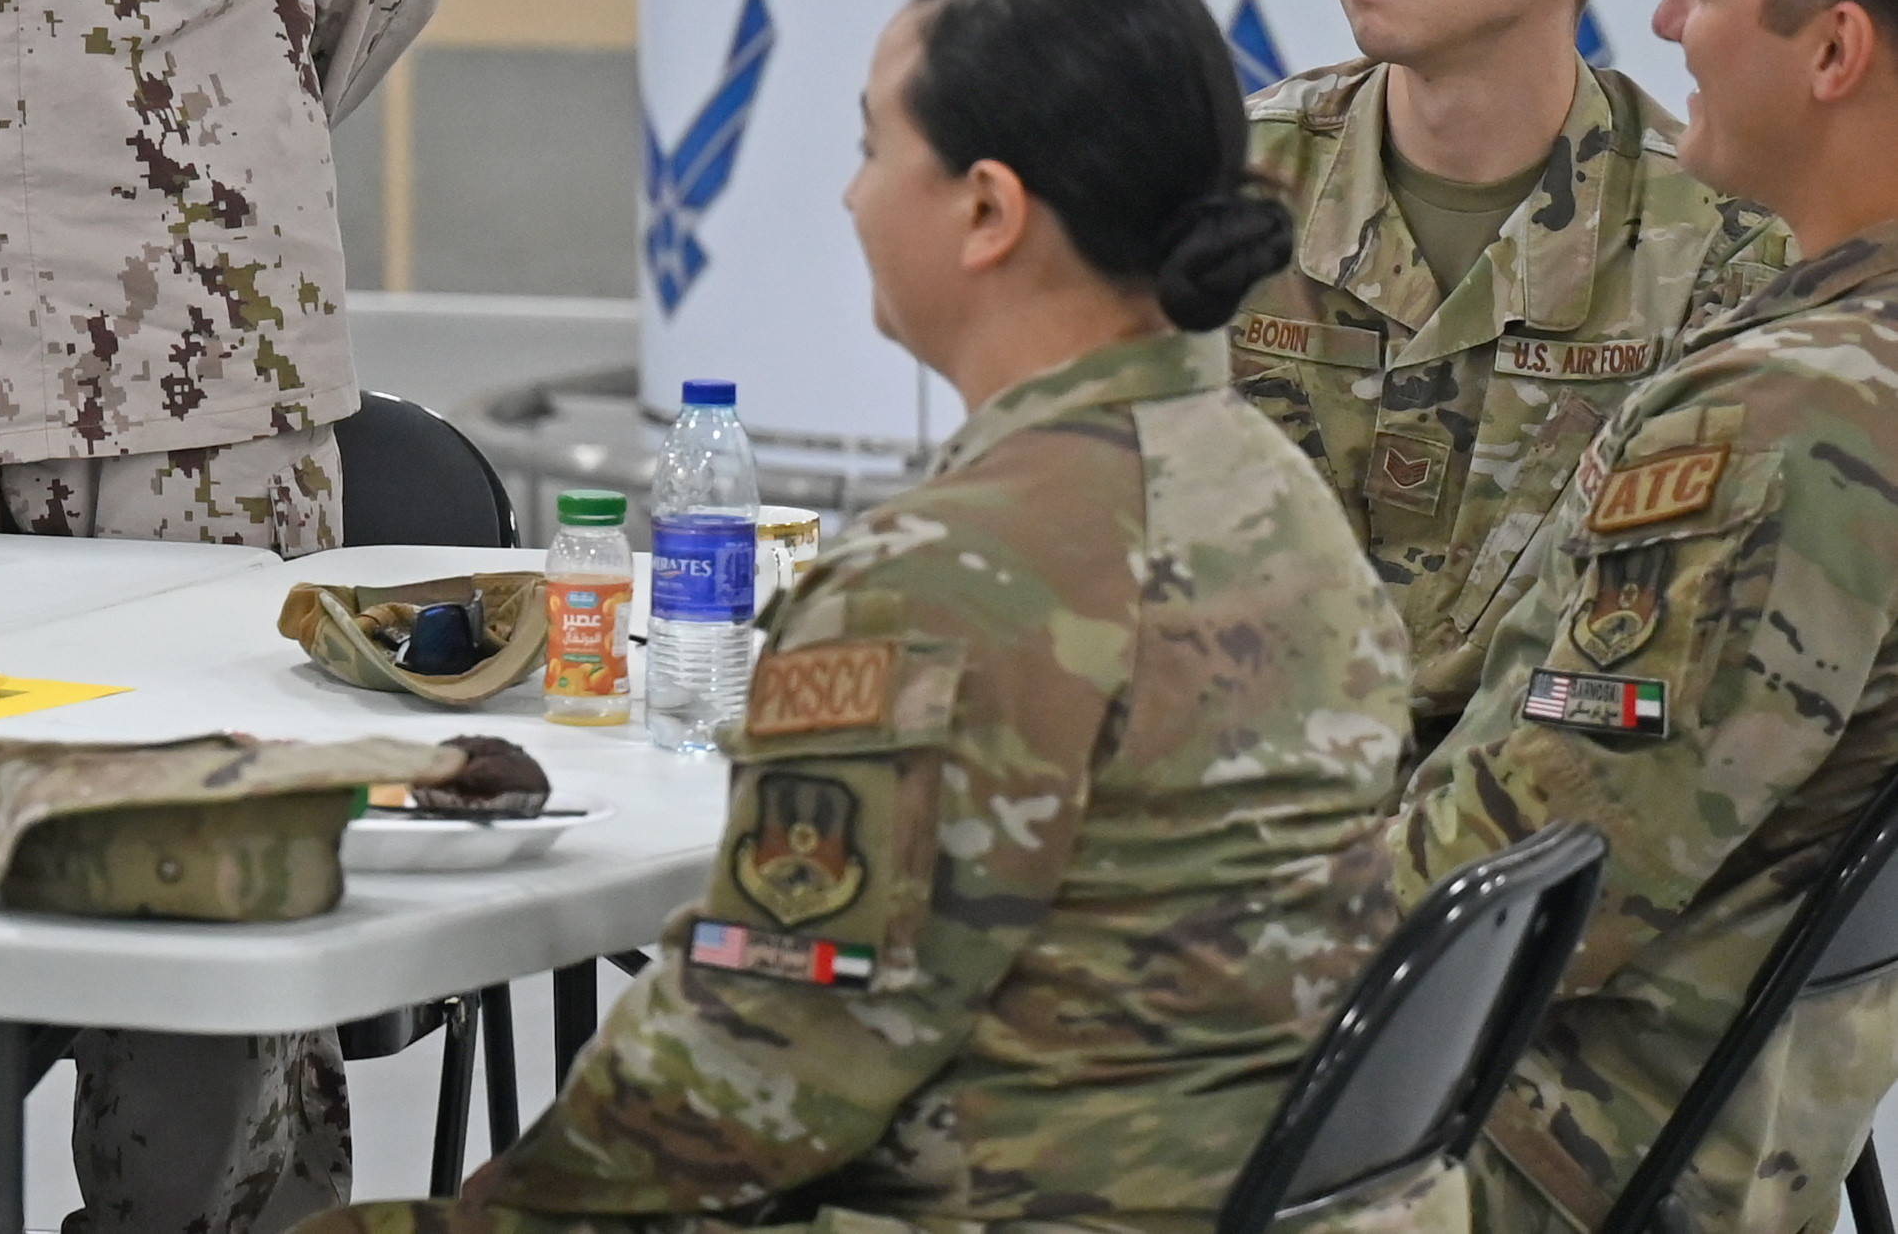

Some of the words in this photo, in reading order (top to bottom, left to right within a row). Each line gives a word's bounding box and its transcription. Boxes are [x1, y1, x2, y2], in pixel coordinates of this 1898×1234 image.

[1246, 316, 1310, 353] BODIN
[1513, 341, 1552, 373] U.S.
[1561, 346, 1598, 374] AIR
[1602, 457, 1715, 520] ATC
[562, 614, 602, 632] عصير
